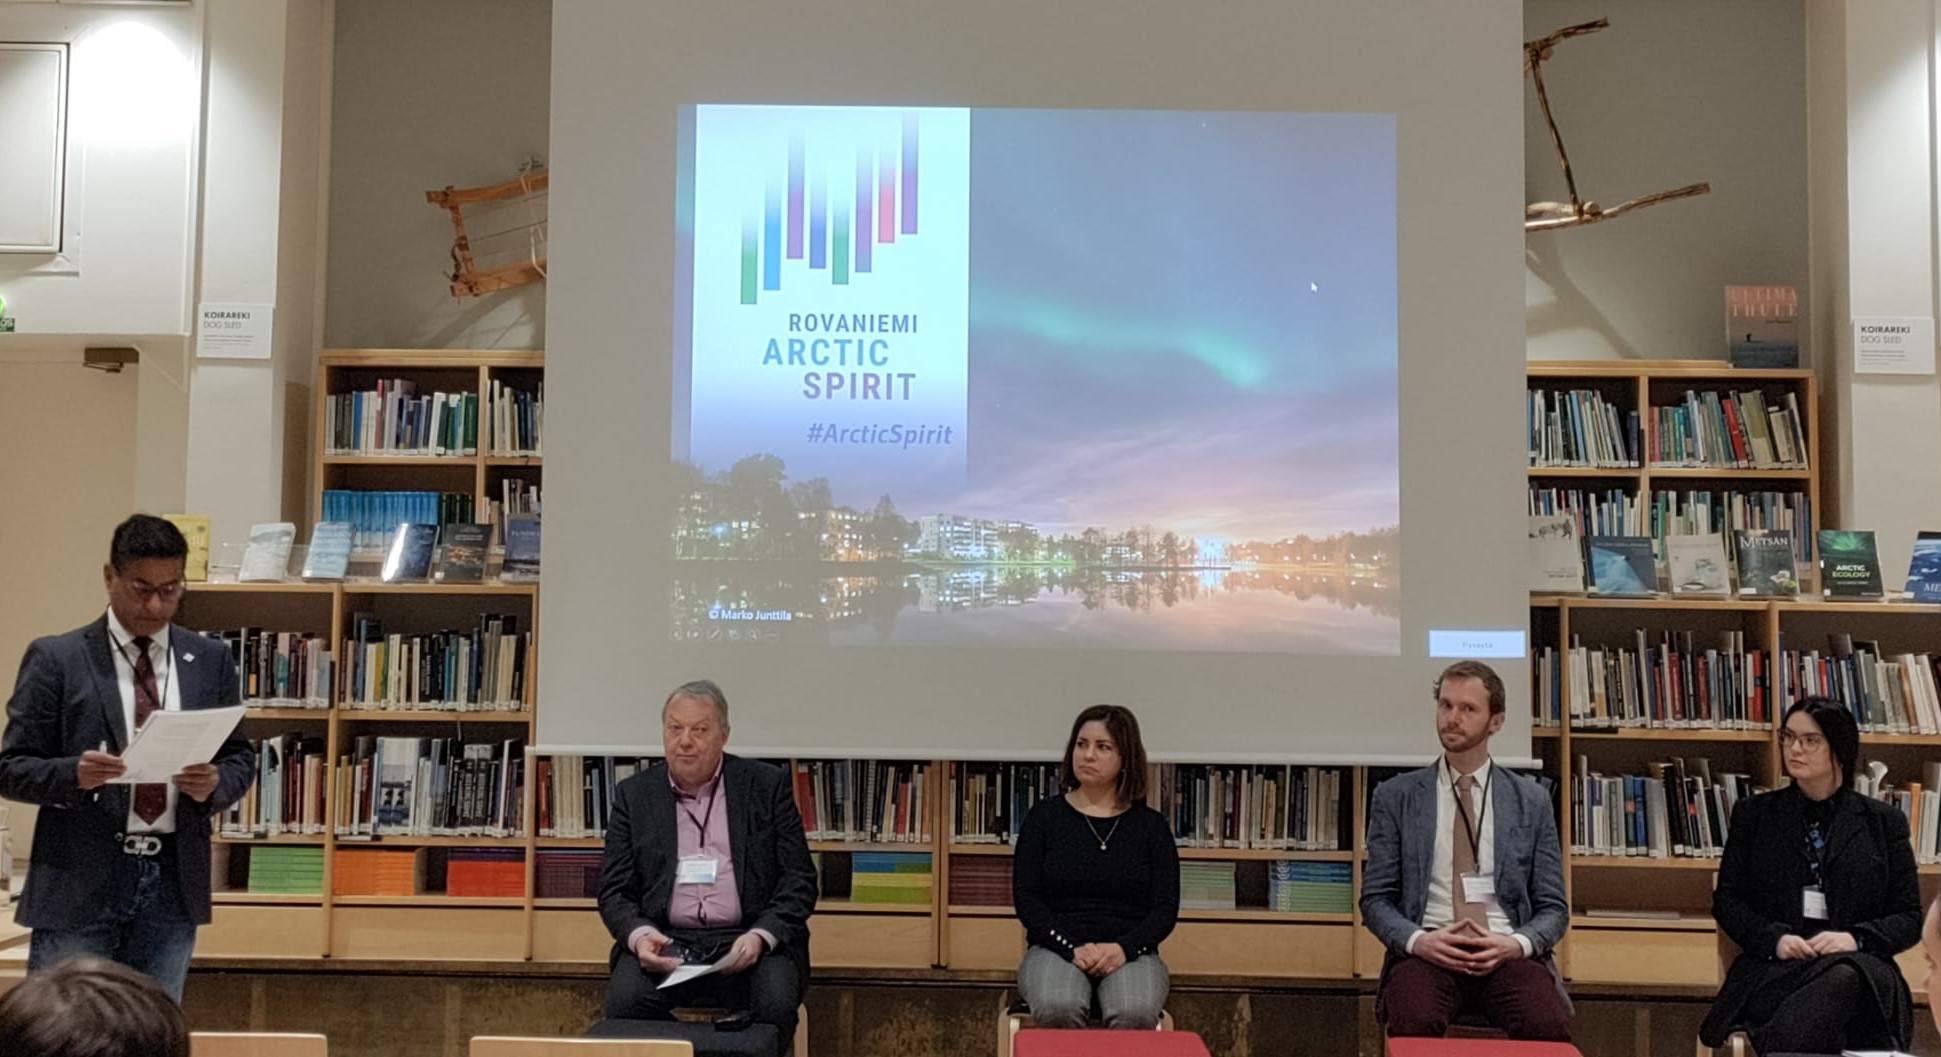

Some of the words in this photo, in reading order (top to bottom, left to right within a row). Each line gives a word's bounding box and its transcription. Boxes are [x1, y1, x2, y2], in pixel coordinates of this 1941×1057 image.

[1731, 287, 1798, 302] ULTIMA
[1731, 303, 1798, 317] THULE
[203, 321, 222, 329] DOG
[224, 321, 242, 329] SLED
[788, 313, 918, 334] ROVANIEMI
[1860, 326, 1911, 334] KOIRAREKI
[1861, 335, 1881, 344] DOG
[1883, 335, 1902, 344] SLED
[762, 338, 889, 366] ARCTIC
[802, 372, 916, 401] SPIRIT
[806, 423, 953, 450] #ArcticSpirit
[1835, 564, 1867, 572] ARCTIC
[721, 610, 753, 620] Marko
[755, 610, 792, 621] Junttila
